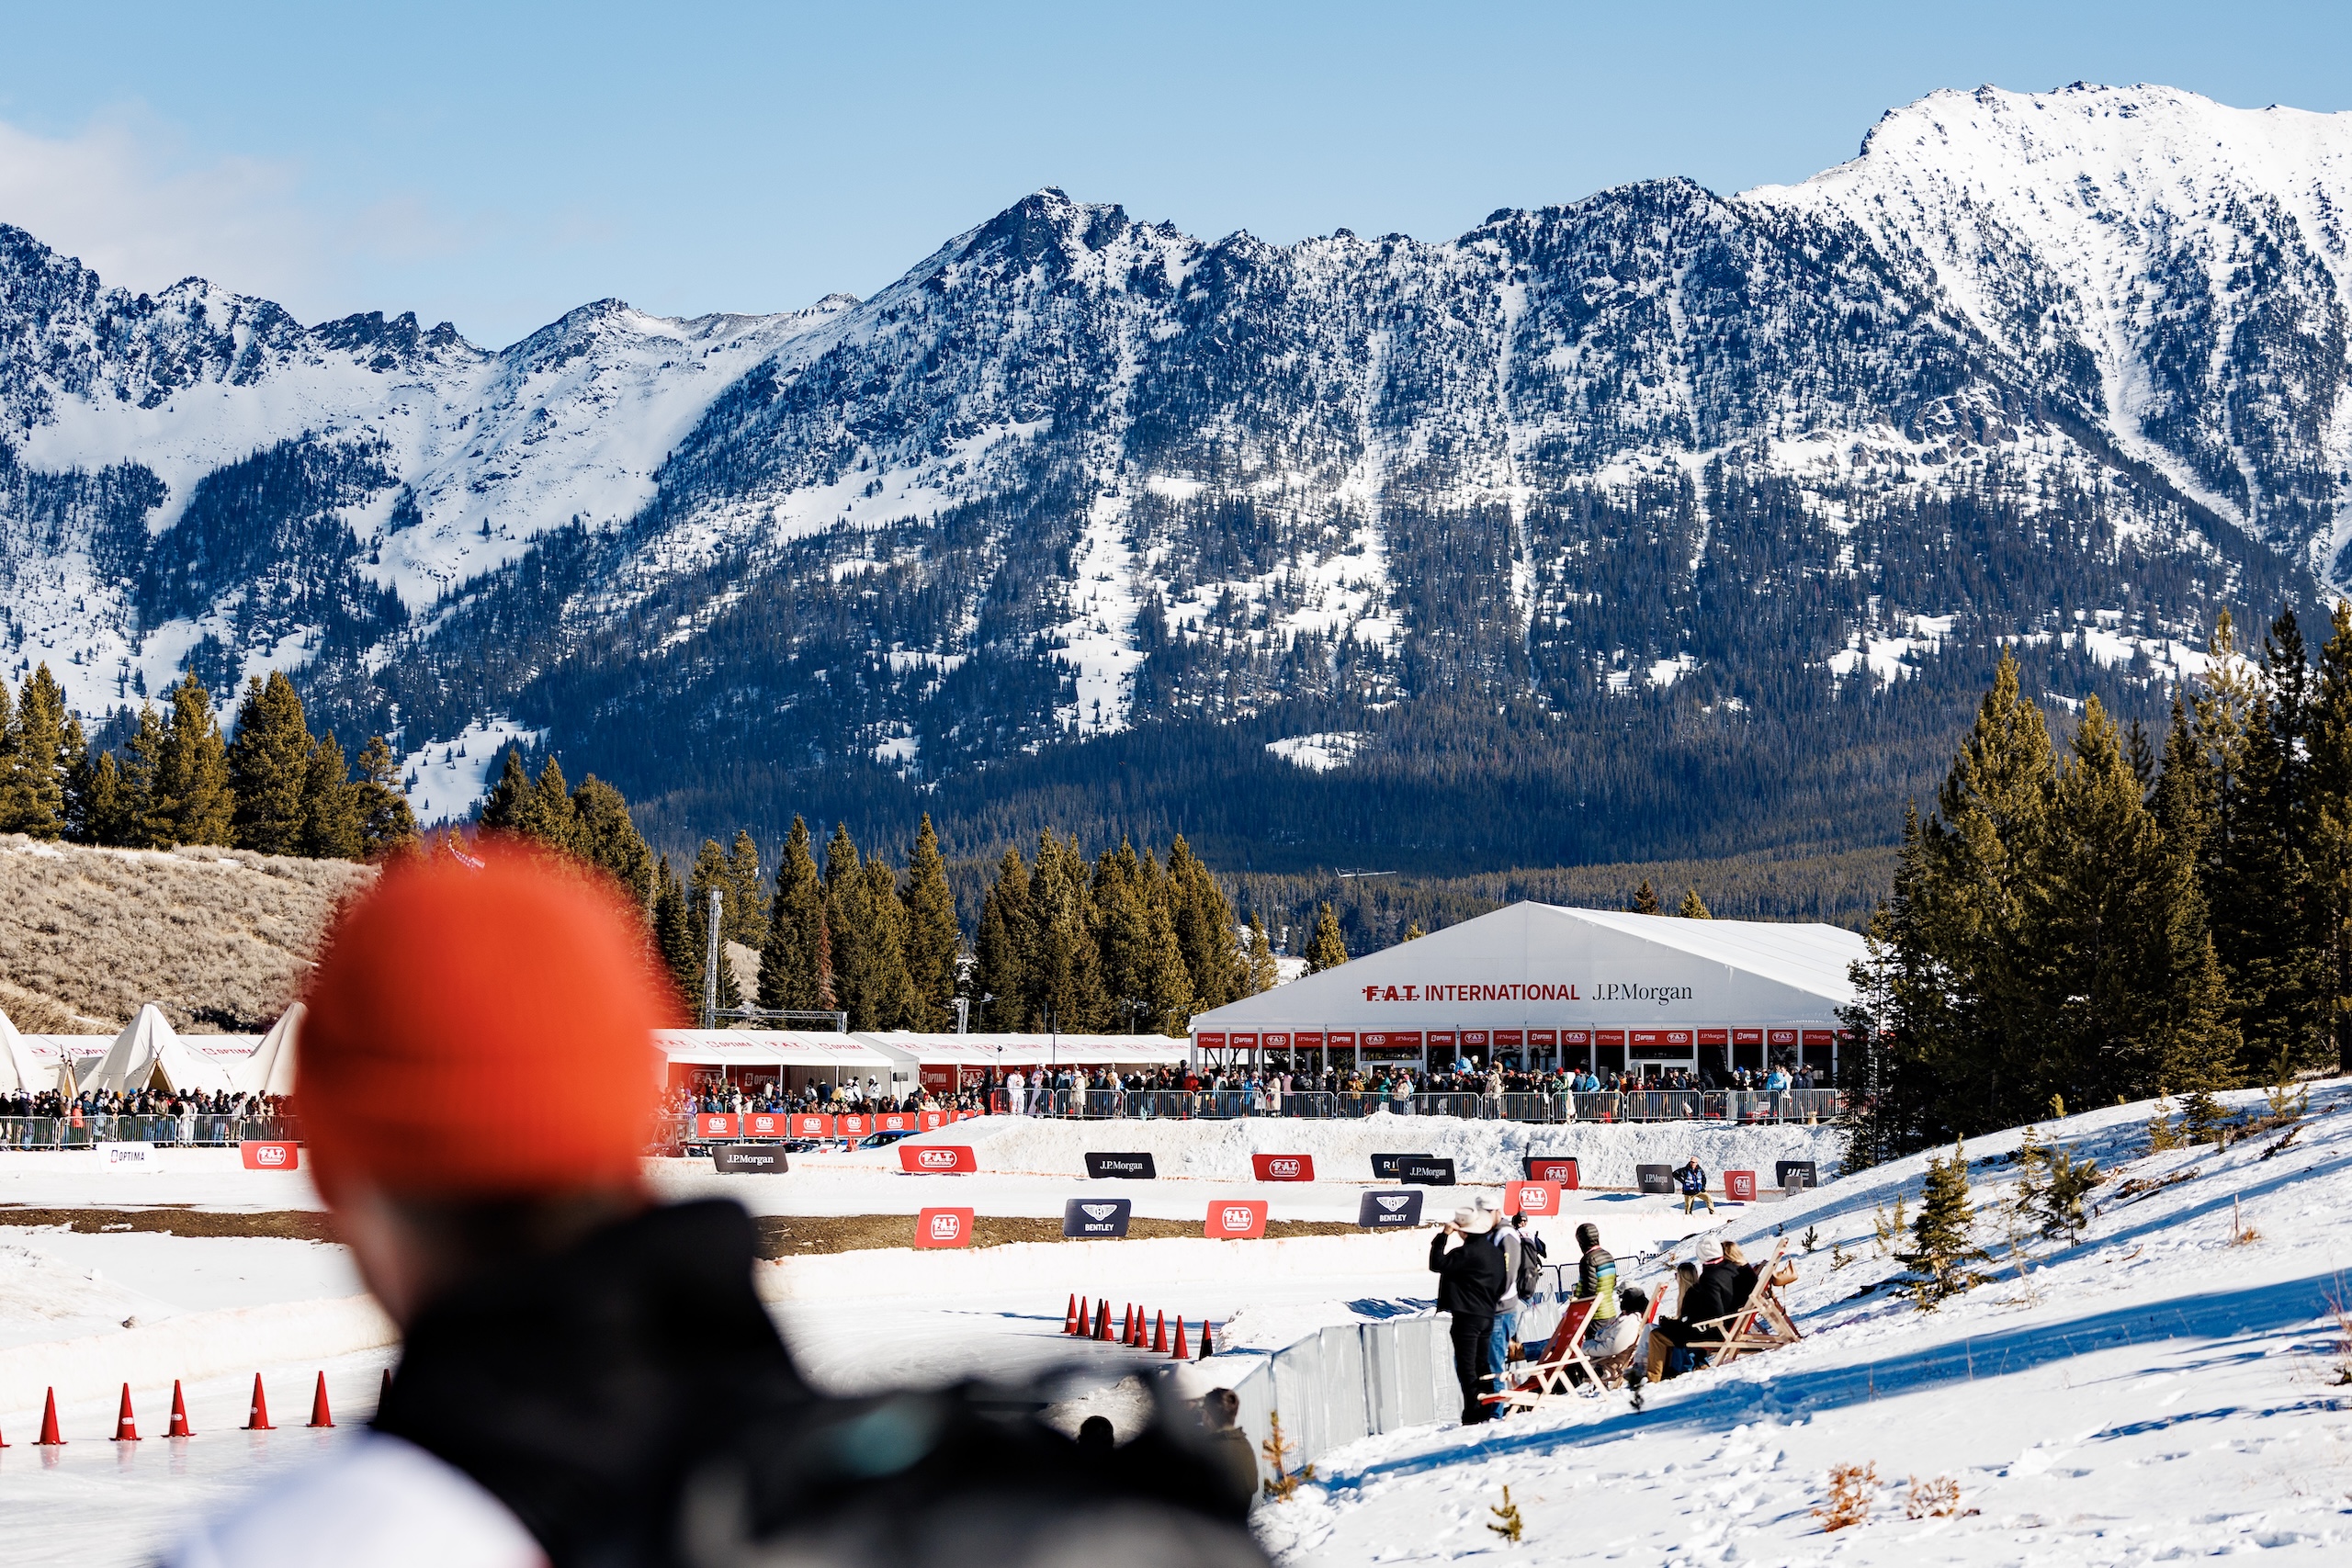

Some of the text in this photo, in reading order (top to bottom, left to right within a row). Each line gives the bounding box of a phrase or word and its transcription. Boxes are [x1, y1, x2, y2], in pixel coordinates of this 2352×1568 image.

[1425, 984, 1580, 1002] INTERNATIONAL
[1592, 983, 1693, 1007] J.P.Morgan
[928, 1073, 946, 1083] OPTIMA
[119, 1151, 145, 1162] OPTIMA
[727, 1155, 774, 1167] J.P.Morgan
[1100, 1161, 1143, 1172] J.P.Morgan
[1409, 1167, 1446, 1179] J.P.Morgan
[1379, 1214, 1408, 1223] BENTLEY
[1085, 1224, 1114, 1232] BENTLEY
